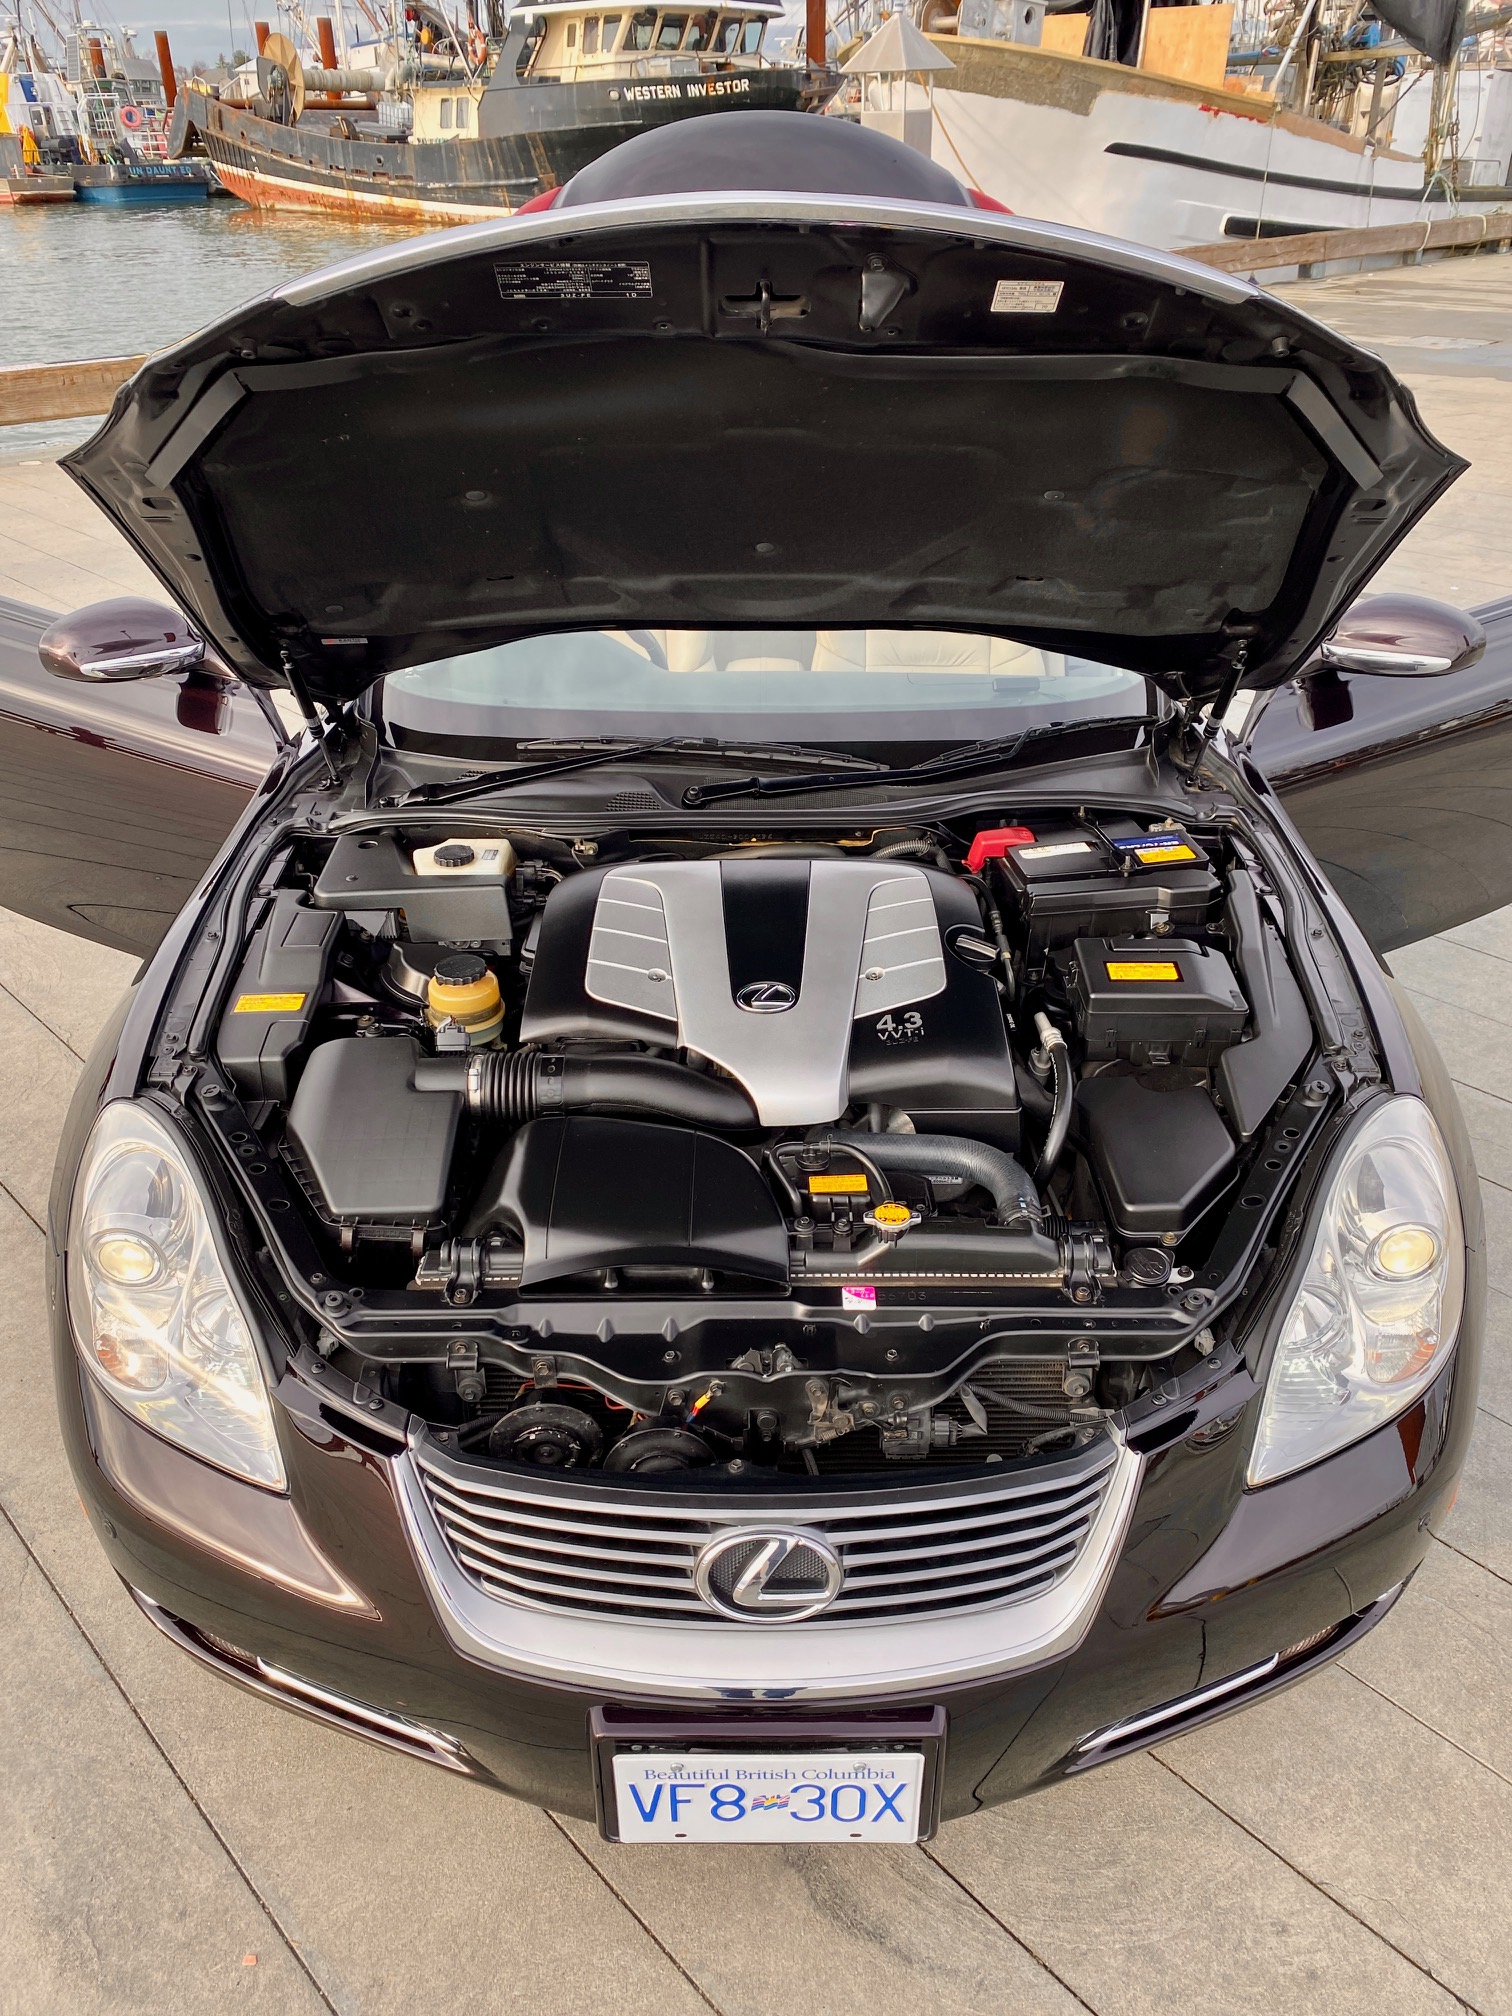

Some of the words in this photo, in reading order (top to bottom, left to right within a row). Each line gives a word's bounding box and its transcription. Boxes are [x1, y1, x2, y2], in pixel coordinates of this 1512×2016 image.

[623, 84, 681, 101] WESTERN
[687, 78, 749, 98] INVESTOR
[876, 1012, 923, 1031] 4.3
[877, 1027, 925, 1040] VVT-i
[644, 1768, 729, 1780] Beautiful
[736, 1768, 797, 1780] British
[801, 1768, 895, 1780] Columbia
[628, 1783, 747, 1823] VF8
[789, 1783, 908, 1823] 30X
